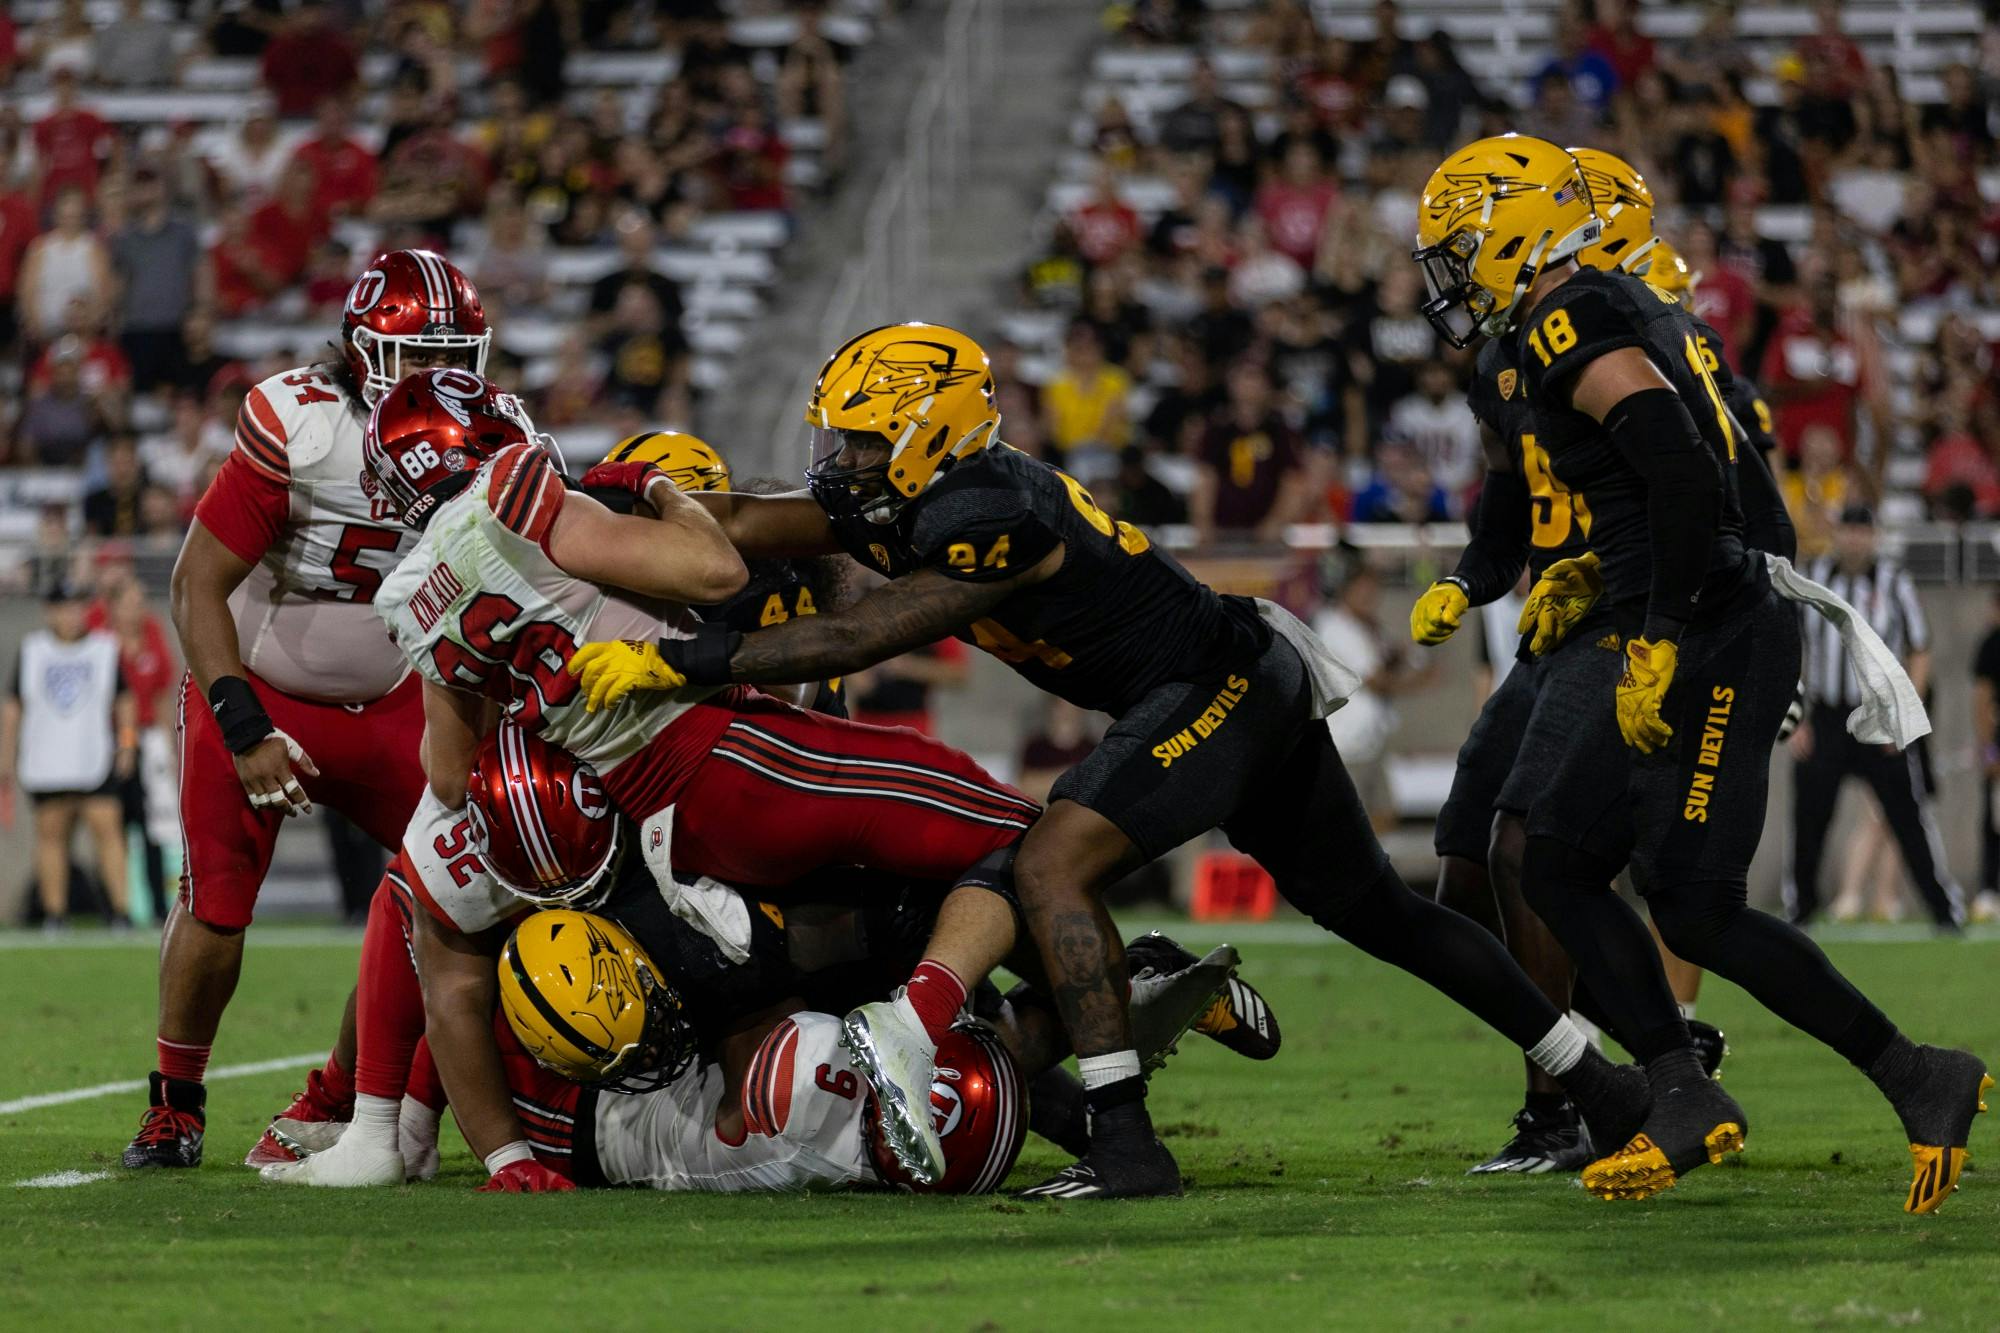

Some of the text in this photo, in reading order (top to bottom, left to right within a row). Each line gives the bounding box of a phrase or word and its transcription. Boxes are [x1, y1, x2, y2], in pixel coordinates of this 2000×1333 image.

[1528, 309, 1577, 367] 18
[282, 371, 340, 406] 54
[400, 440, 440, 480] 86
[404, 493, 436, 526] UTES
[312, 523, 403, 604] 5
[948, 534, 1010, 573] 94
[408, 561, 464, 634] KINCAID
[760, 586, 818, 628] 44
[1151, 674, 1249, 768] SUN DEVILS
[1683, 685, 1735, 823] SUN DEVILS
[433, 816, 487, 889] 52
